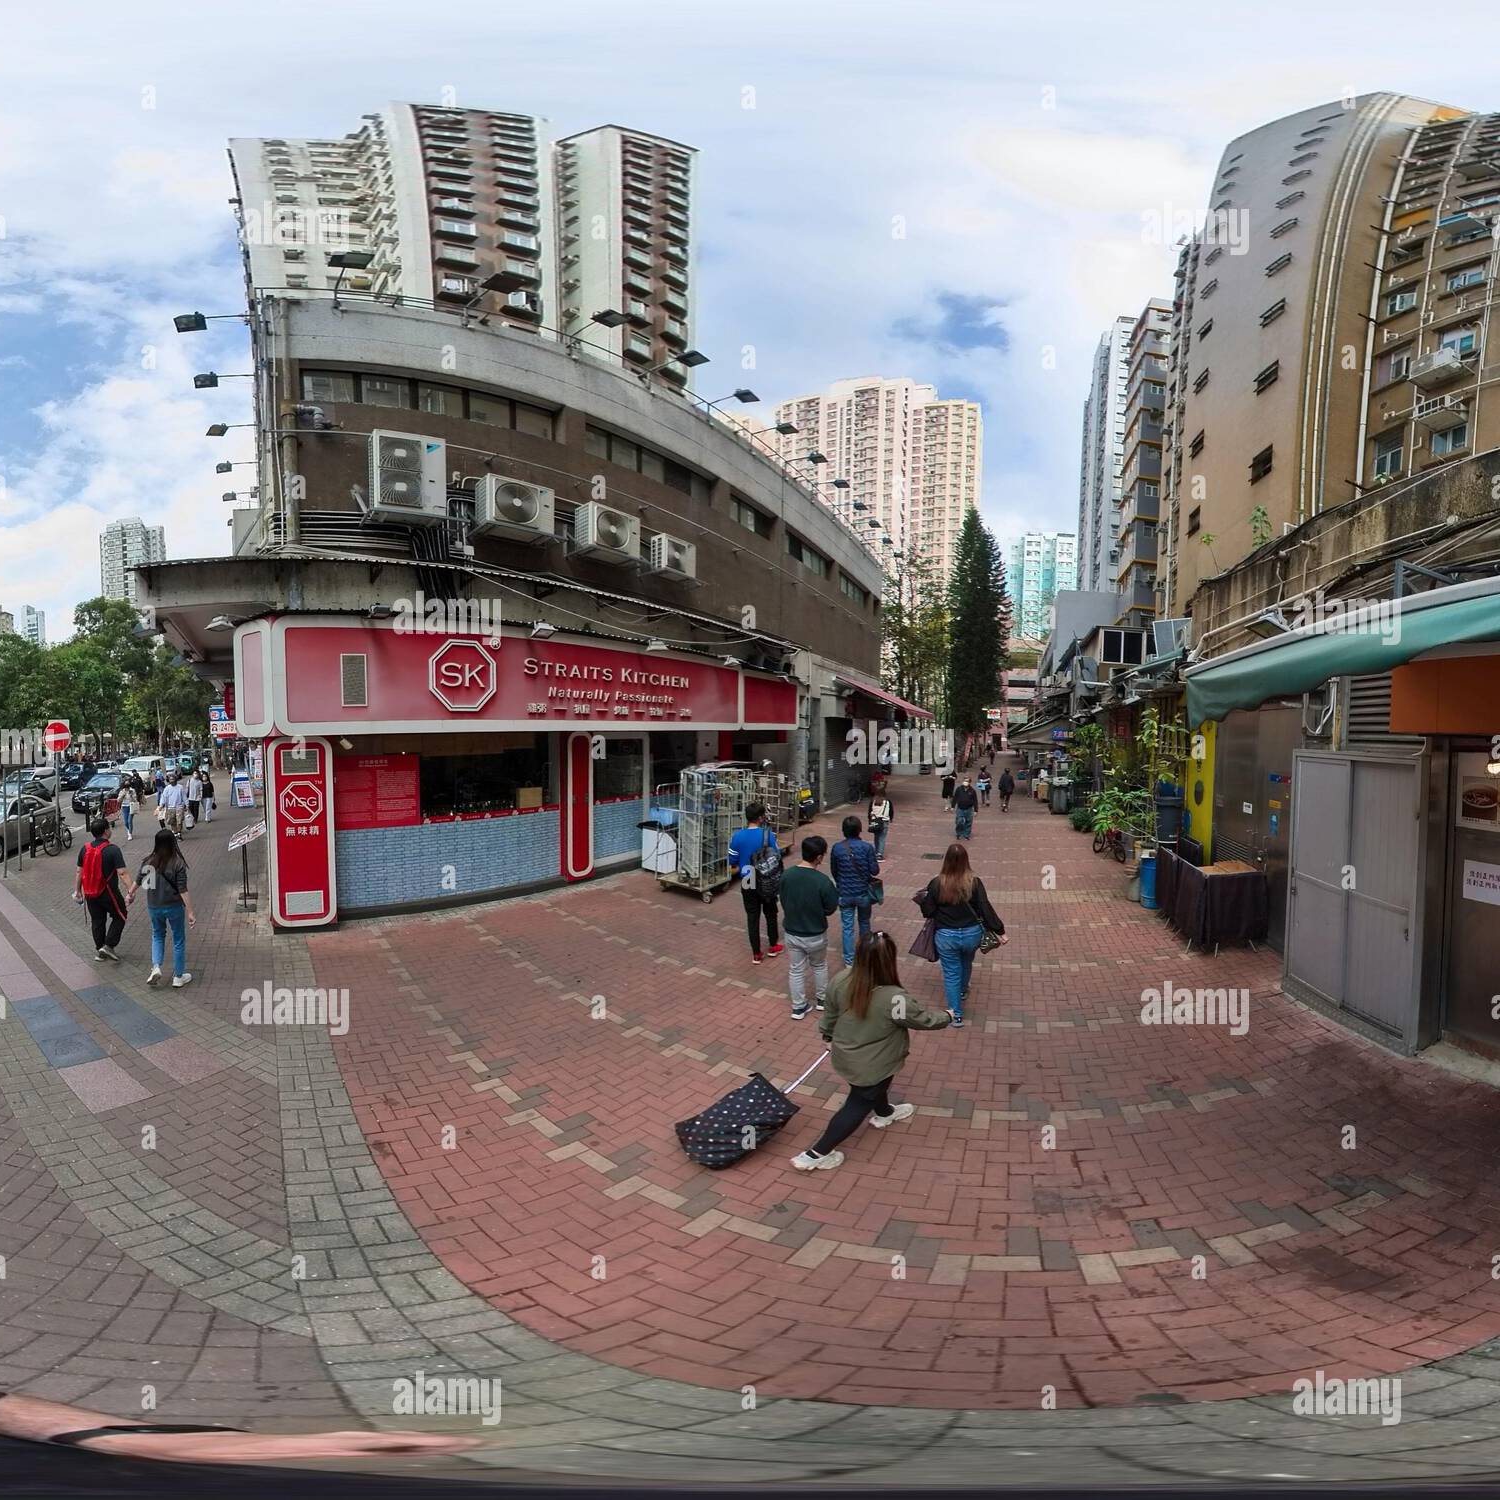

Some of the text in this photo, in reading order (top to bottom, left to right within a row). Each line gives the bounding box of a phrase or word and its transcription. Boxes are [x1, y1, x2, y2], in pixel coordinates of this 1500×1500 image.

[440, 662, 485, 688] SK
[523, 657, 689, 689] STRAITS KITCHEN
[548, 686, 675, 704] Naturally Passionate
[285, 796, 317, 807] MSG
[285, 825, 320, 836] 無味精
